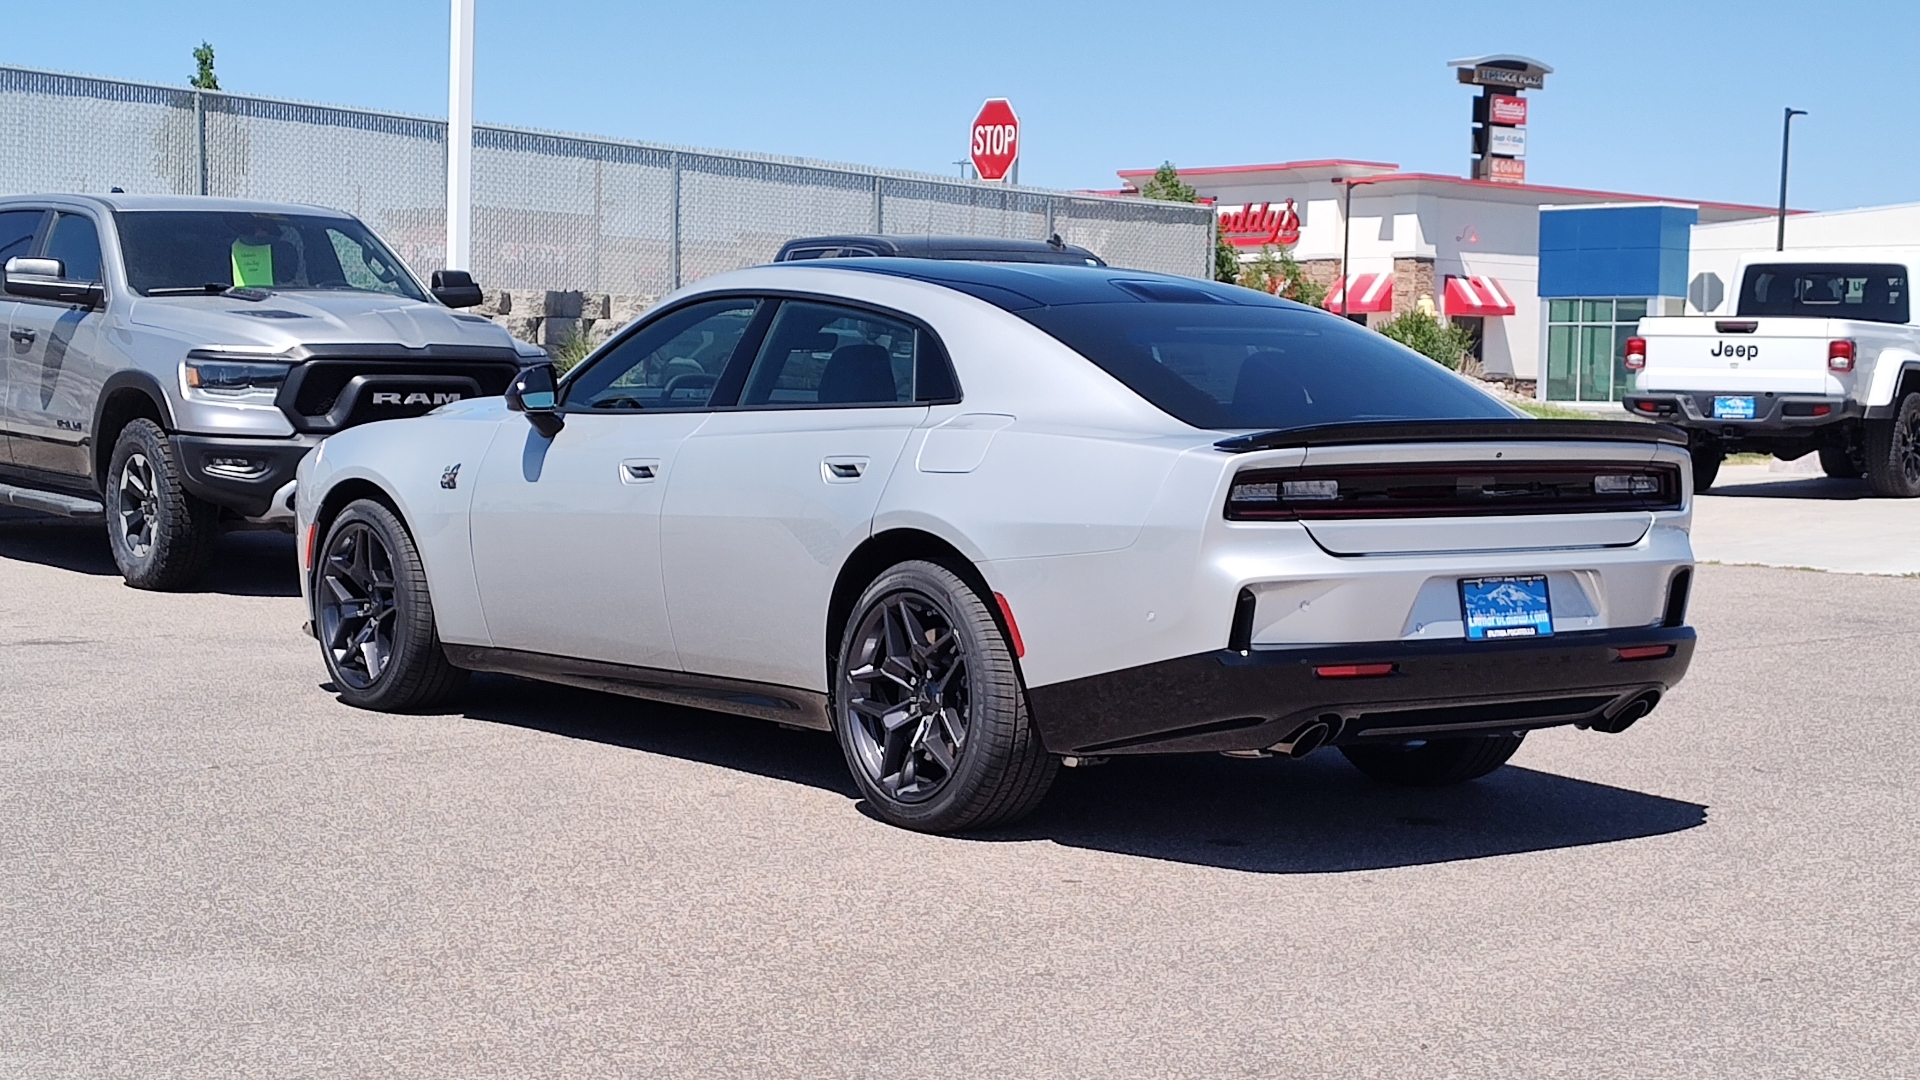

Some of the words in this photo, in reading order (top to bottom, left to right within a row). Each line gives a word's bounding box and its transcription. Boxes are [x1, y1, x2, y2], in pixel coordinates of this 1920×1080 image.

[973, 124, 1016, 156] STOP
[1219, 198, 1300, 244] eddy's
[1711, 340, 1759, 361] Jeep
[372, 392, 461, 405] RAM
